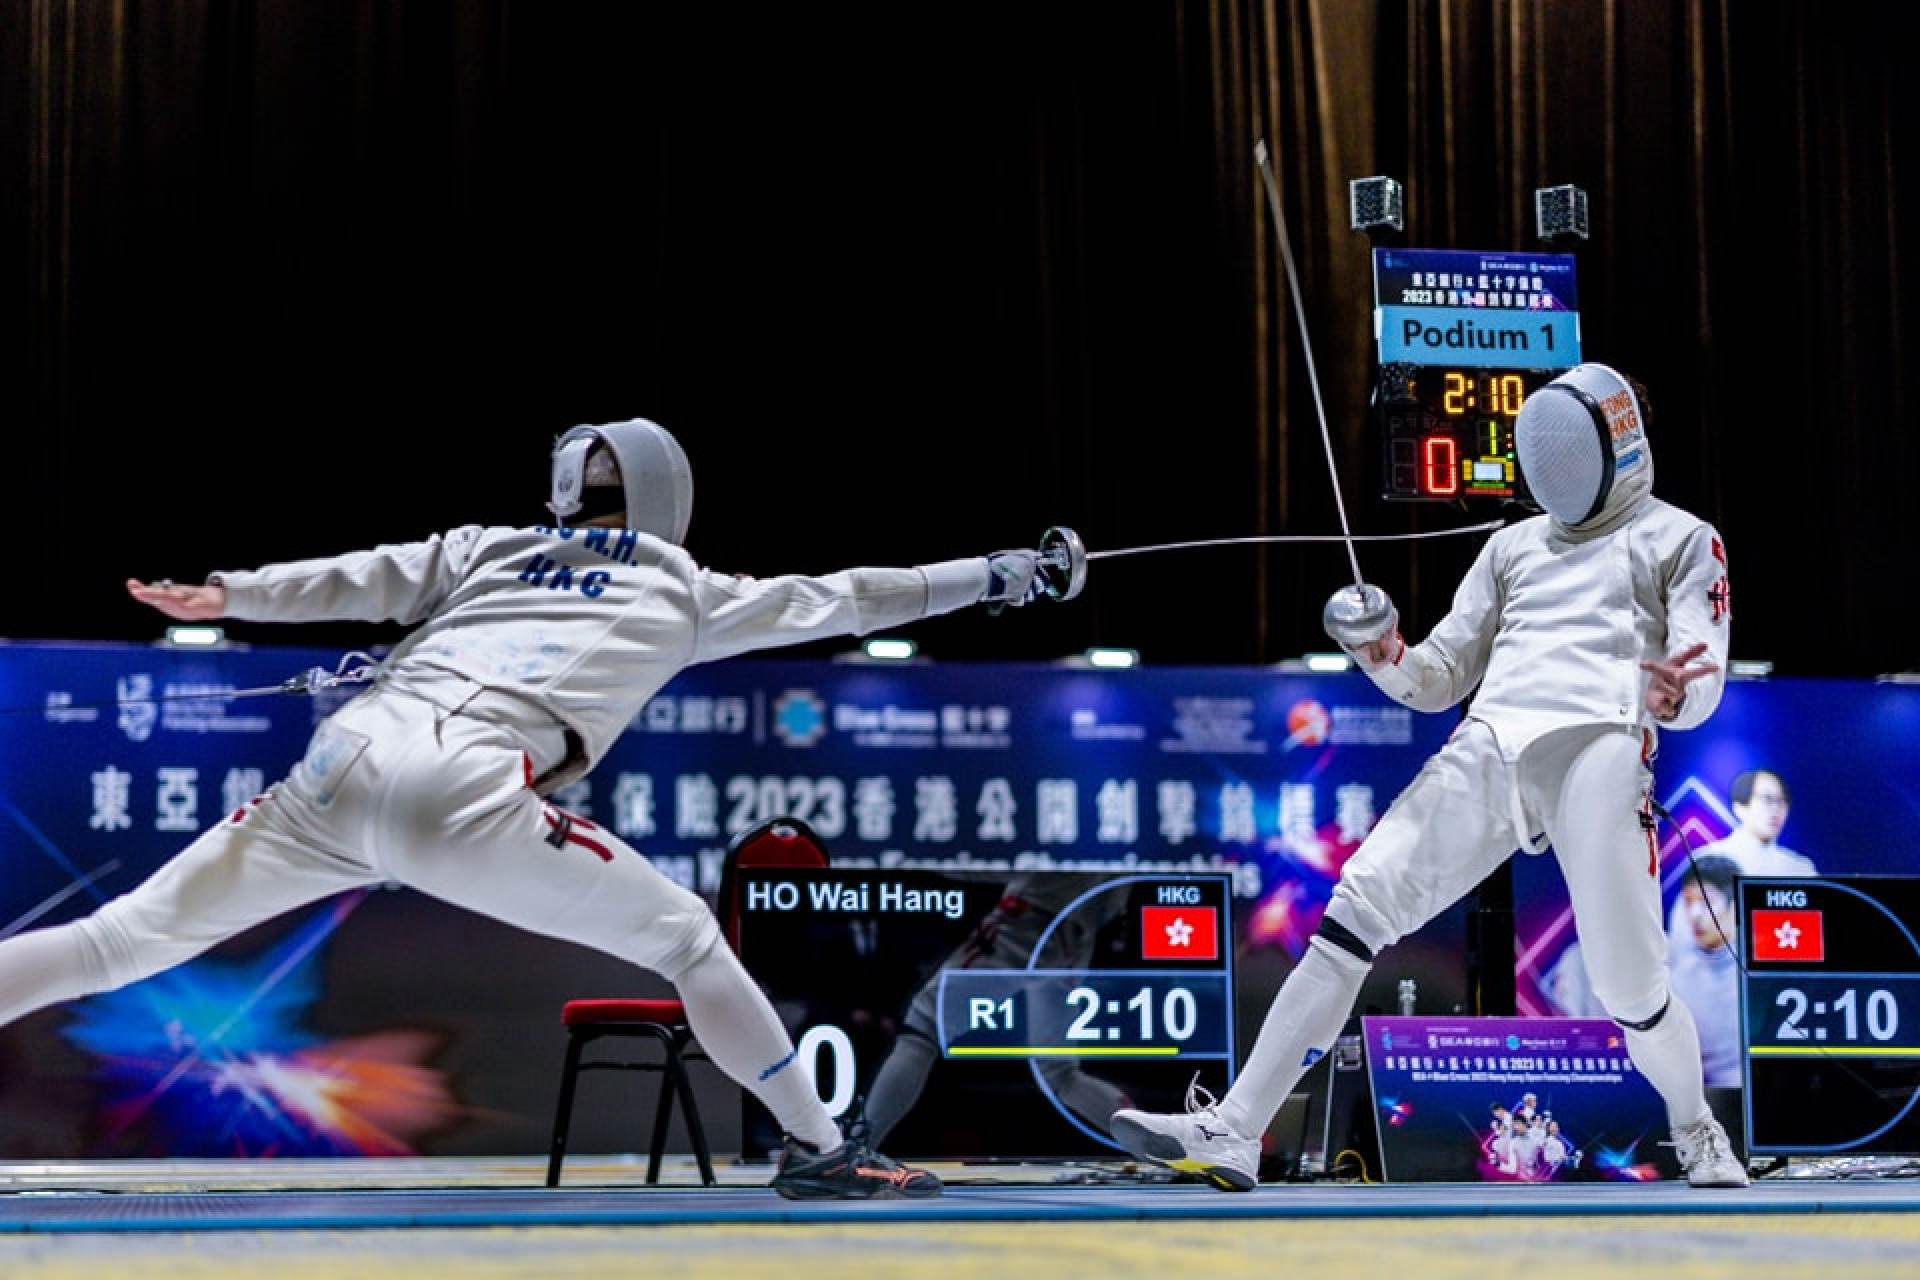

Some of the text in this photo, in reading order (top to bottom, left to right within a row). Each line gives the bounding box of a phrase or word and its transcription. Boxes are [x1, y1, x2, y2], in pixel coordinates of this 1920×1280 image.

[1403, 319, 1554, 350] Podium 1
[1444, 371, 1524, 415] 2:10
[1426, 437, 1457, 494] 0
[747, 882, 965, 918] HO Wai Hang
[1157, 886, 1200, 905] HKG
[1766, 890, 1807, 907] HKG
[969, 987, 1197, 1040] R1 2:10
[1775, 988, 1899, 1040] 2:10
[797, 1024, 857, 1119] 0
